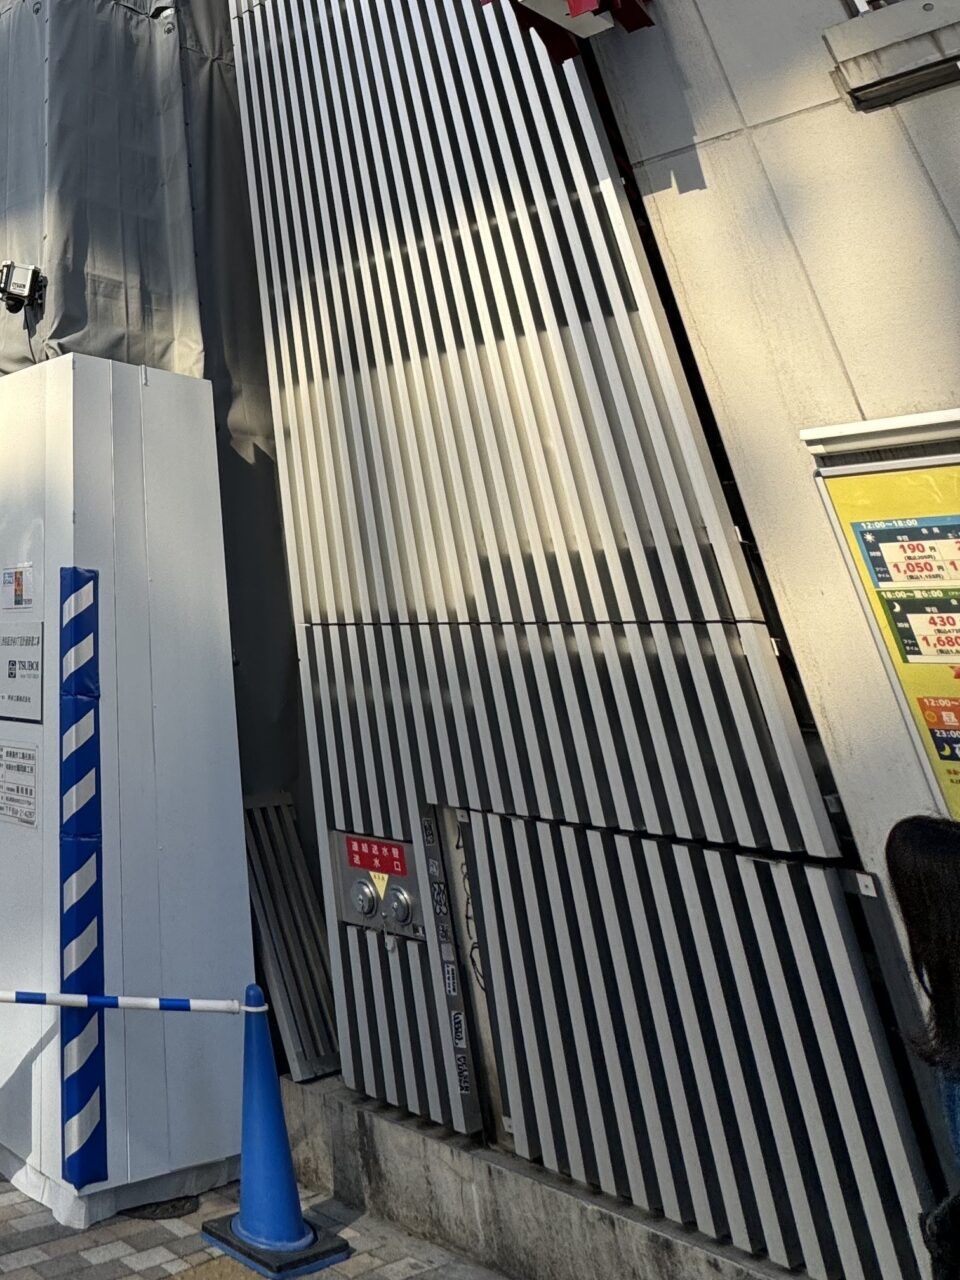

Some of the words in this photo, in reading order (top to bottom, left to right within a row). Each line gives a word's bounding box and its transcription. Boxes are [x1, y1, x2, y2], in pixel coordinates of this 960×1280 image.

[899, 543, 926, 554] 190
[893, 561, 934, 575] 1,050
[928, 616, 956, 627] 430
[18, 660, 39, 671] TSUBOI
